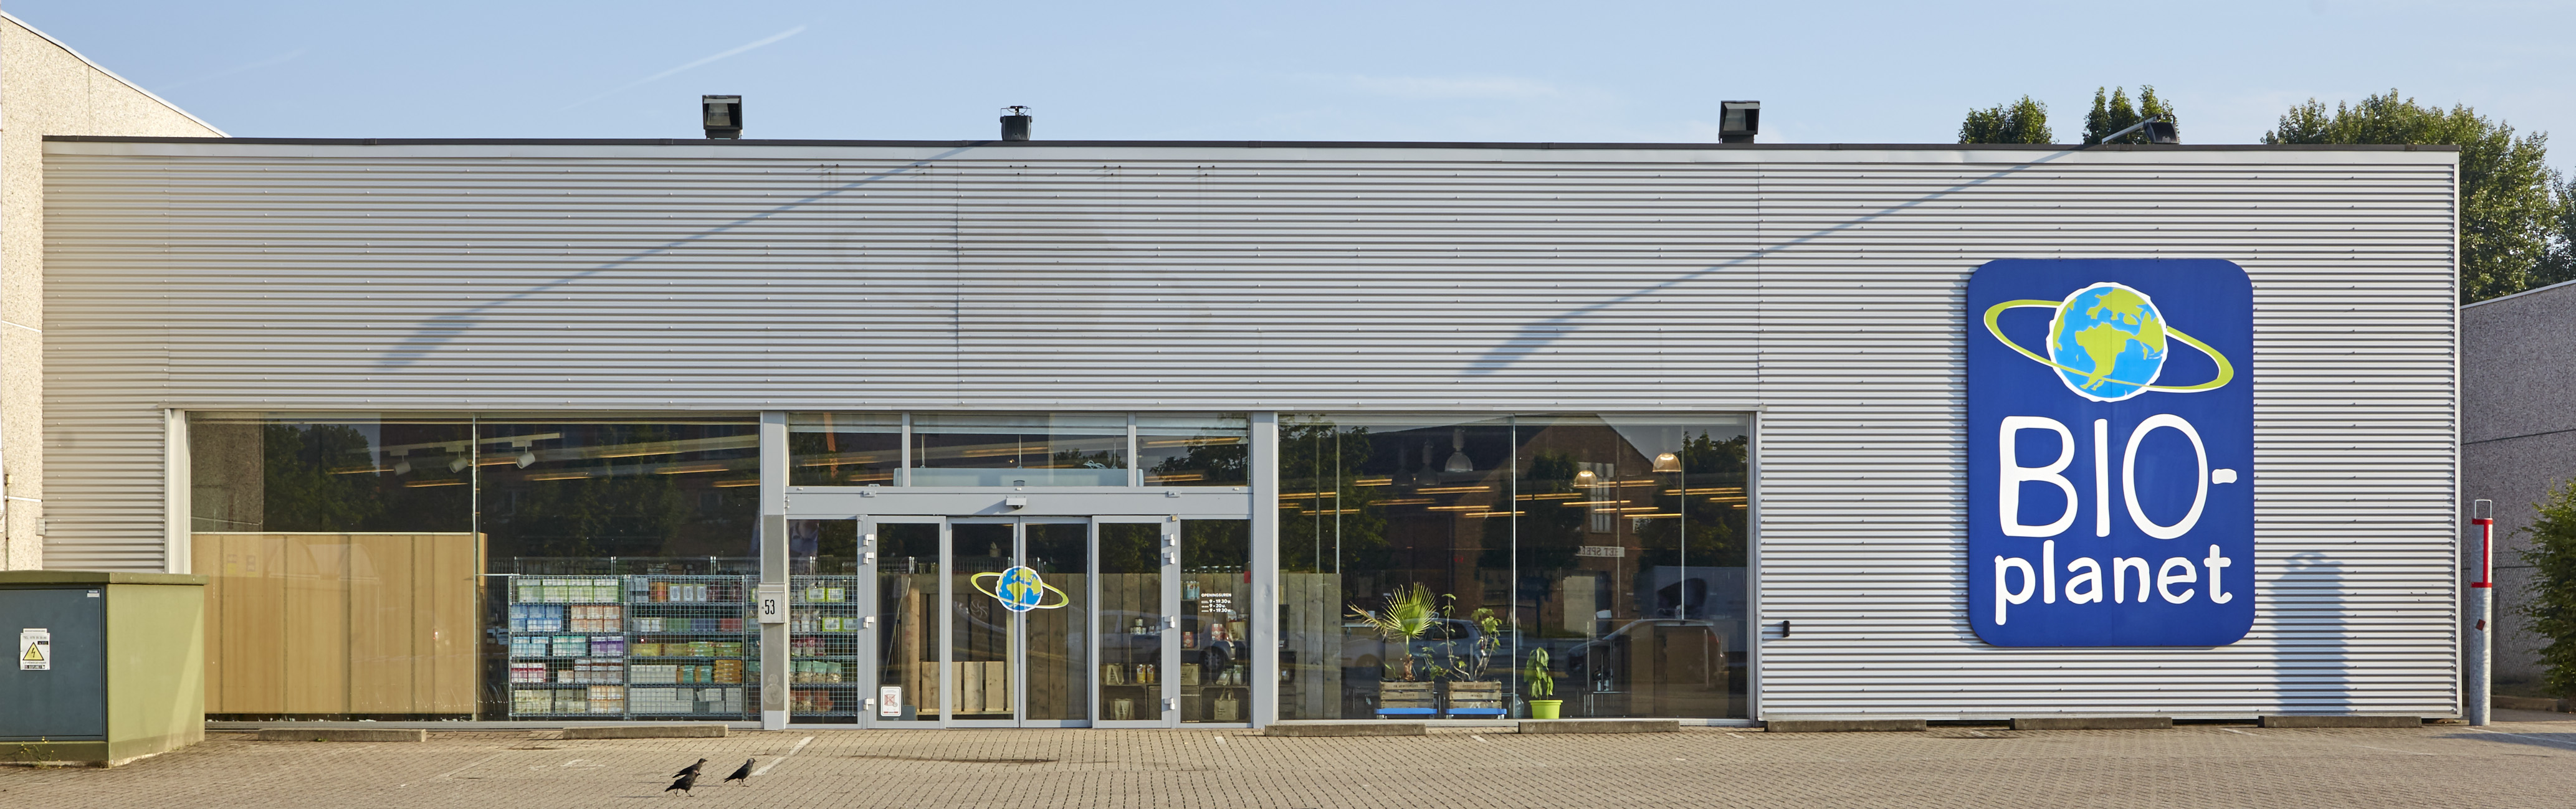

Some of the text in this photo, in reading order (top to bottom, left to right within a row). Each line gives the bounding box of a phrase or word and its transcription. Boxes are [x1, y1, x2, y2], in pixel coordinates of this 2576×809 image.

[1999, 413, 2238, 539] BIO-
[765, 599, 775, 615] 53
[1995, 539, 2233, 625] planet
